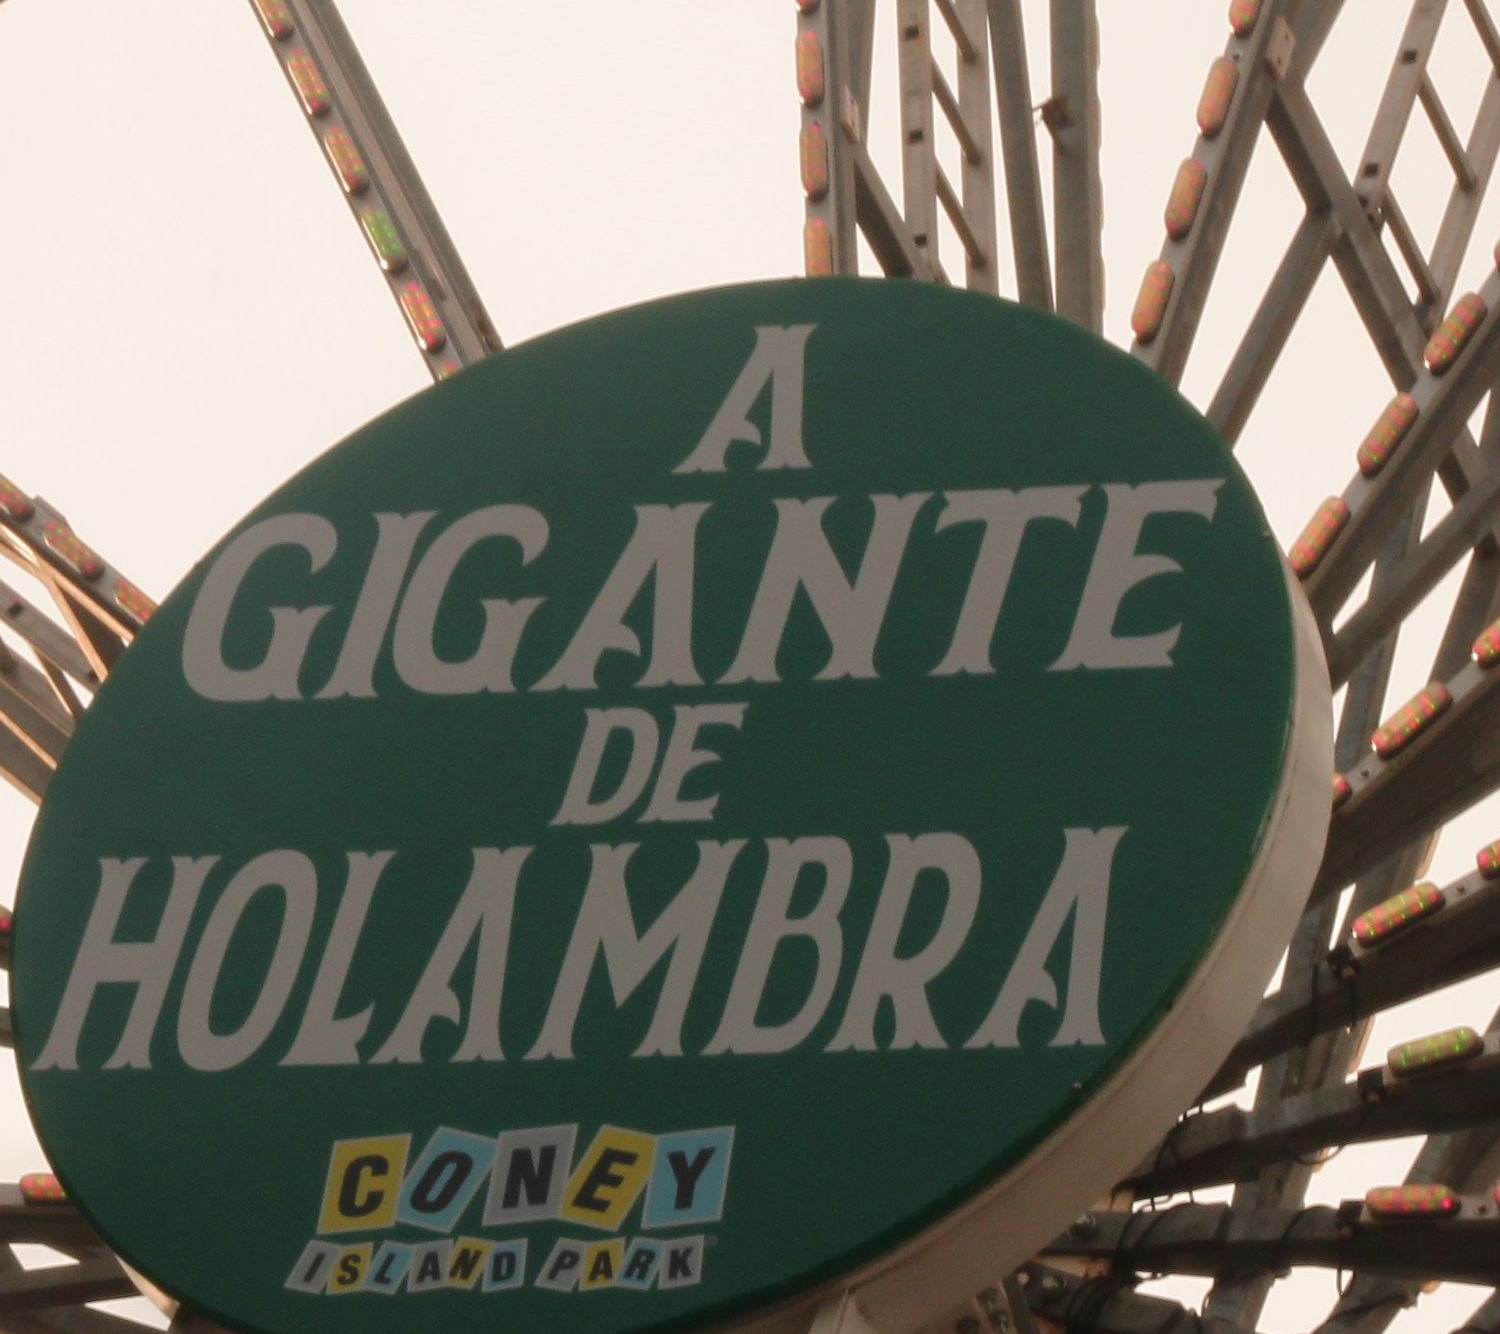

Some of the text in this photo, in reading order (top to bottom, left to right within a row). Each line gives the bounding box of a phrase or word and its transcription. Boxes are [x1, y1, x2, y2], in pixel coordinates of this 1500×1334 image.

[673, 324, 818, 474] A
[180, 477, 1228, 703] GIGANTE
[550, 703, 747, 826] DE
[31, 824, 1130, 1072] HOLAMBRA
[330, 1135, 723, 1225] CONEY
[300, 1242, 698, 1289] ISLAND PARK
